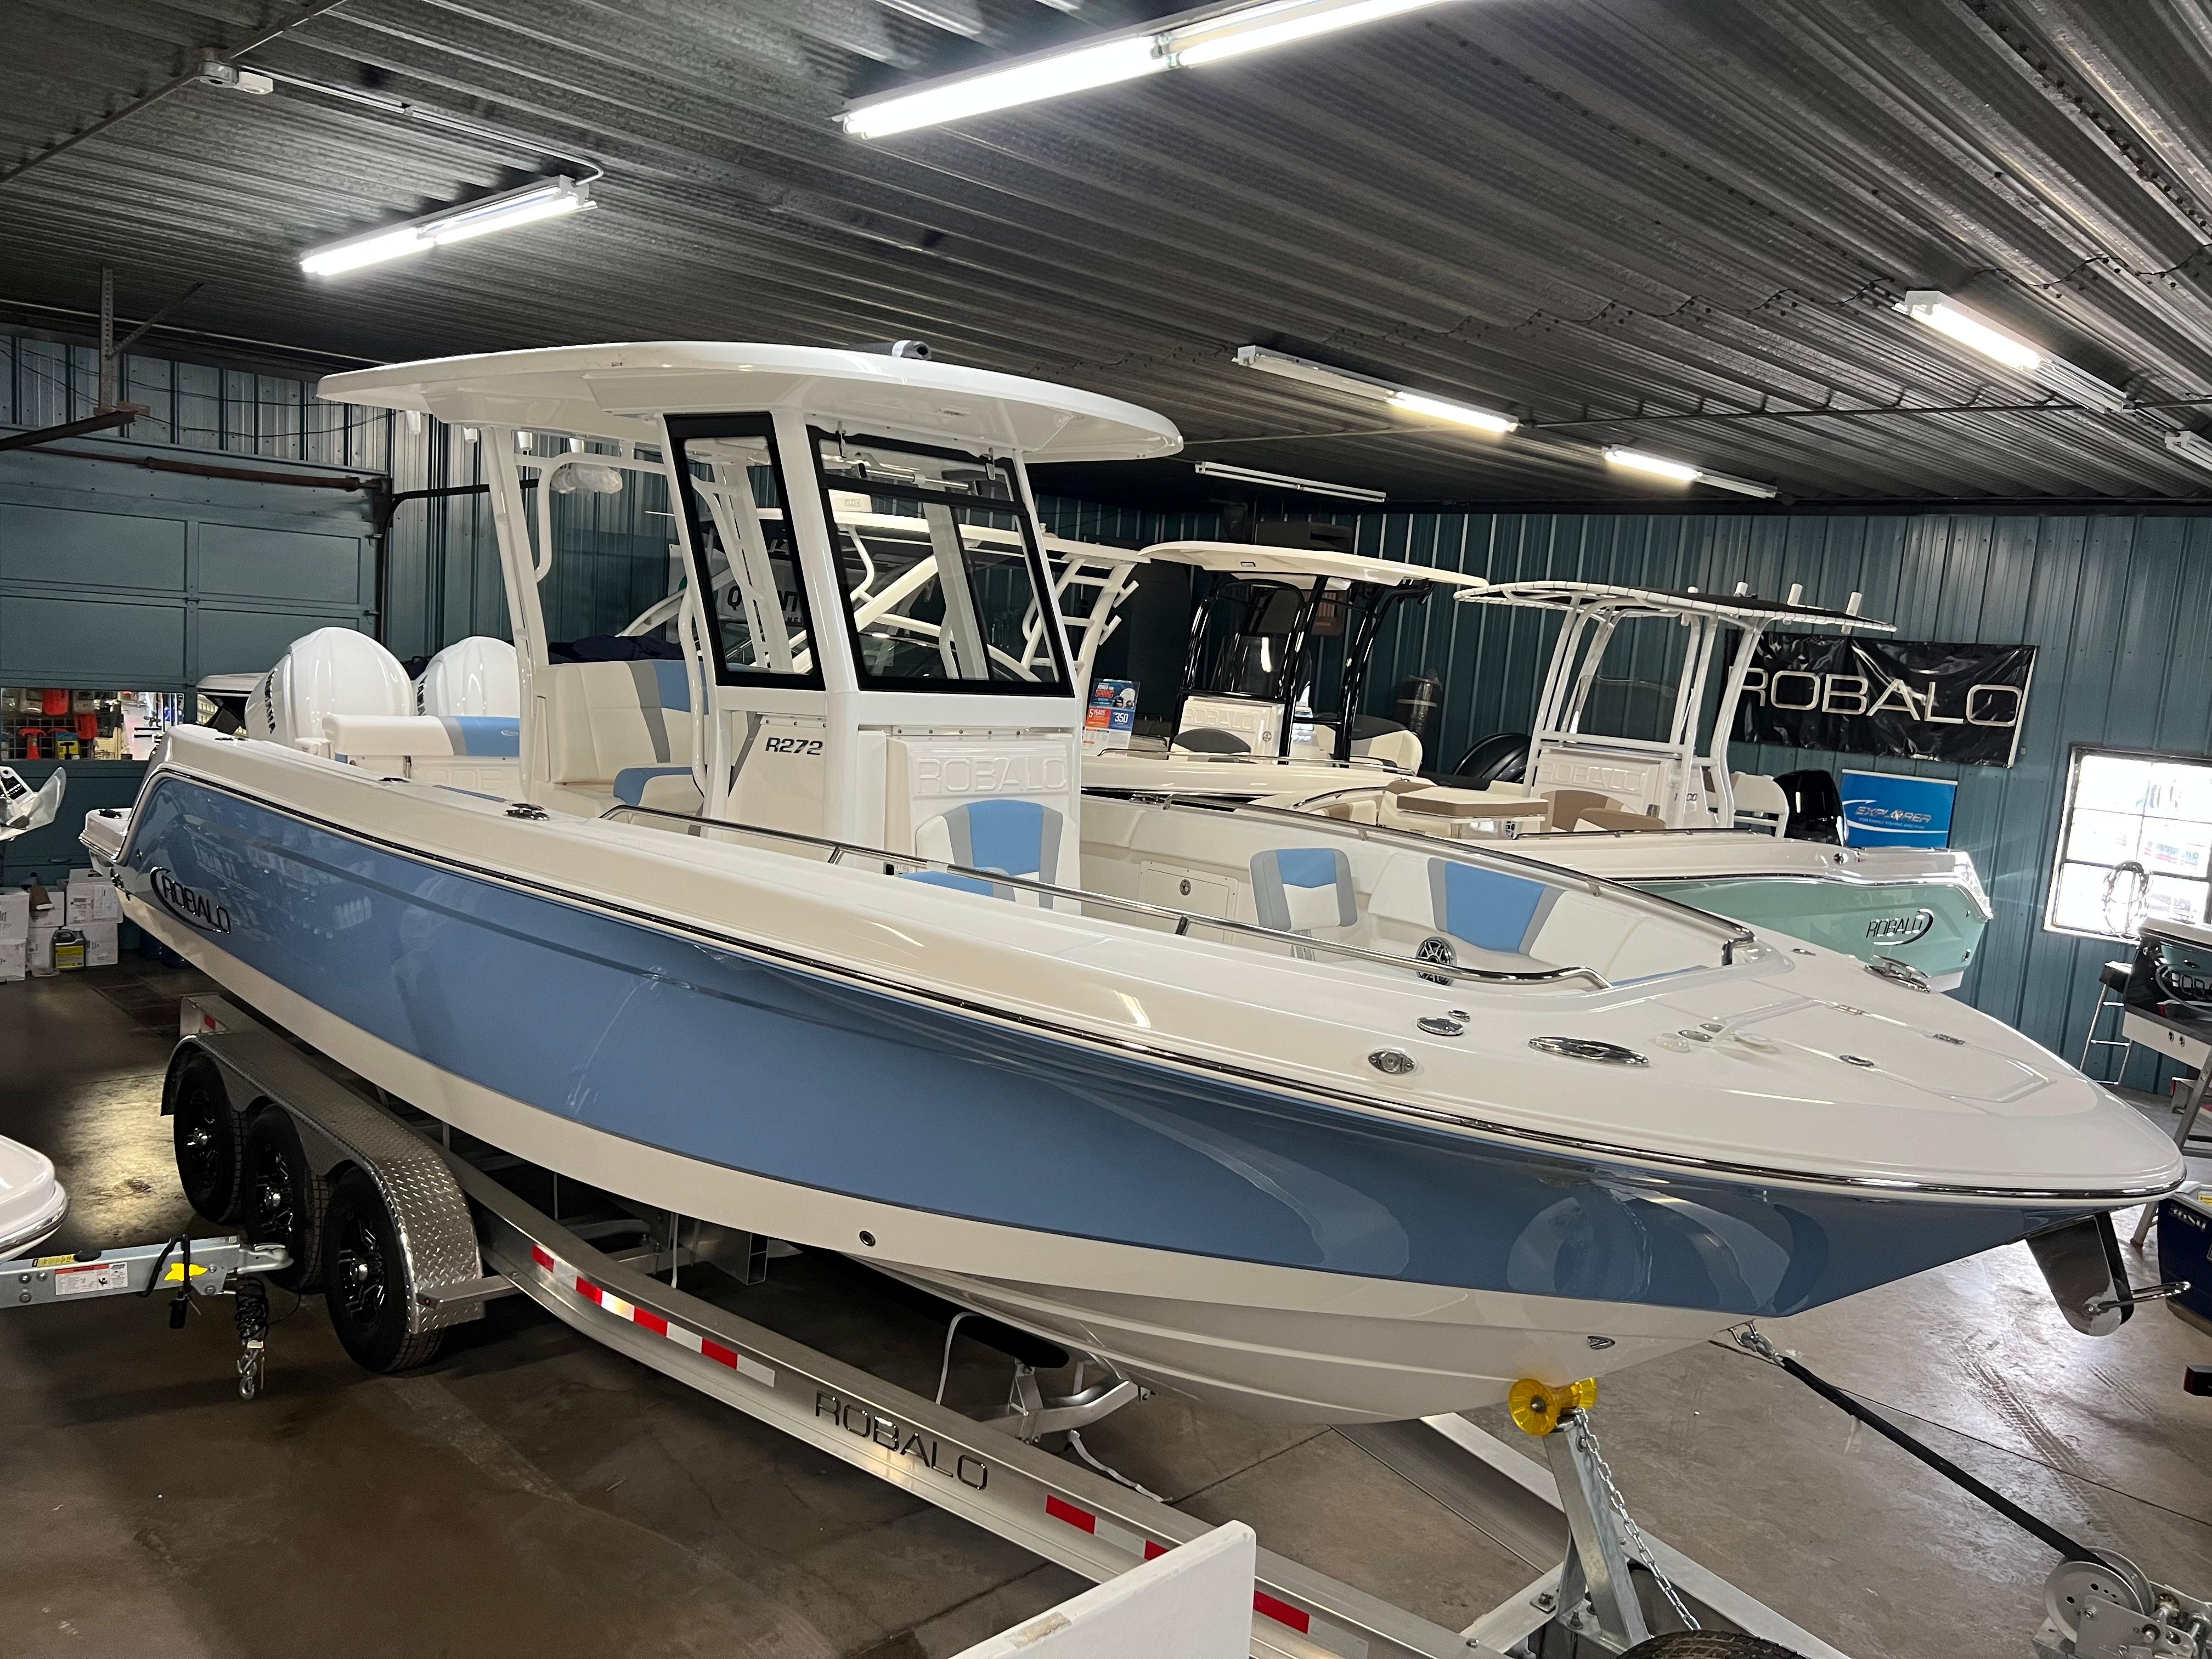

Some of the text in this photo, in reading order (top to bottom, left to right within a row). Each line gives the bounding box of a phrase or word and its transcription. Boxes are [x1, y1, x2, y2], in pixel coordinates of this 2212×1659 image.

[1729, 665, 2022, 727] ROBALO
[1088, 709, 1093, 718] 5
[1114, 713, 1129, 724] 350
[765, 737, 823, 755] R272
[916, 757, 1067, 794] ROBALO
[1539, 761, 1642, 791] ROBALO
[1854, 806, 1932, 823] EXPLORER
[162, 874, 231, 934] ROBALO
[1865, 914, 1925, 938] ROBALO
[815, 1389, 988, 1491] ROBALO
